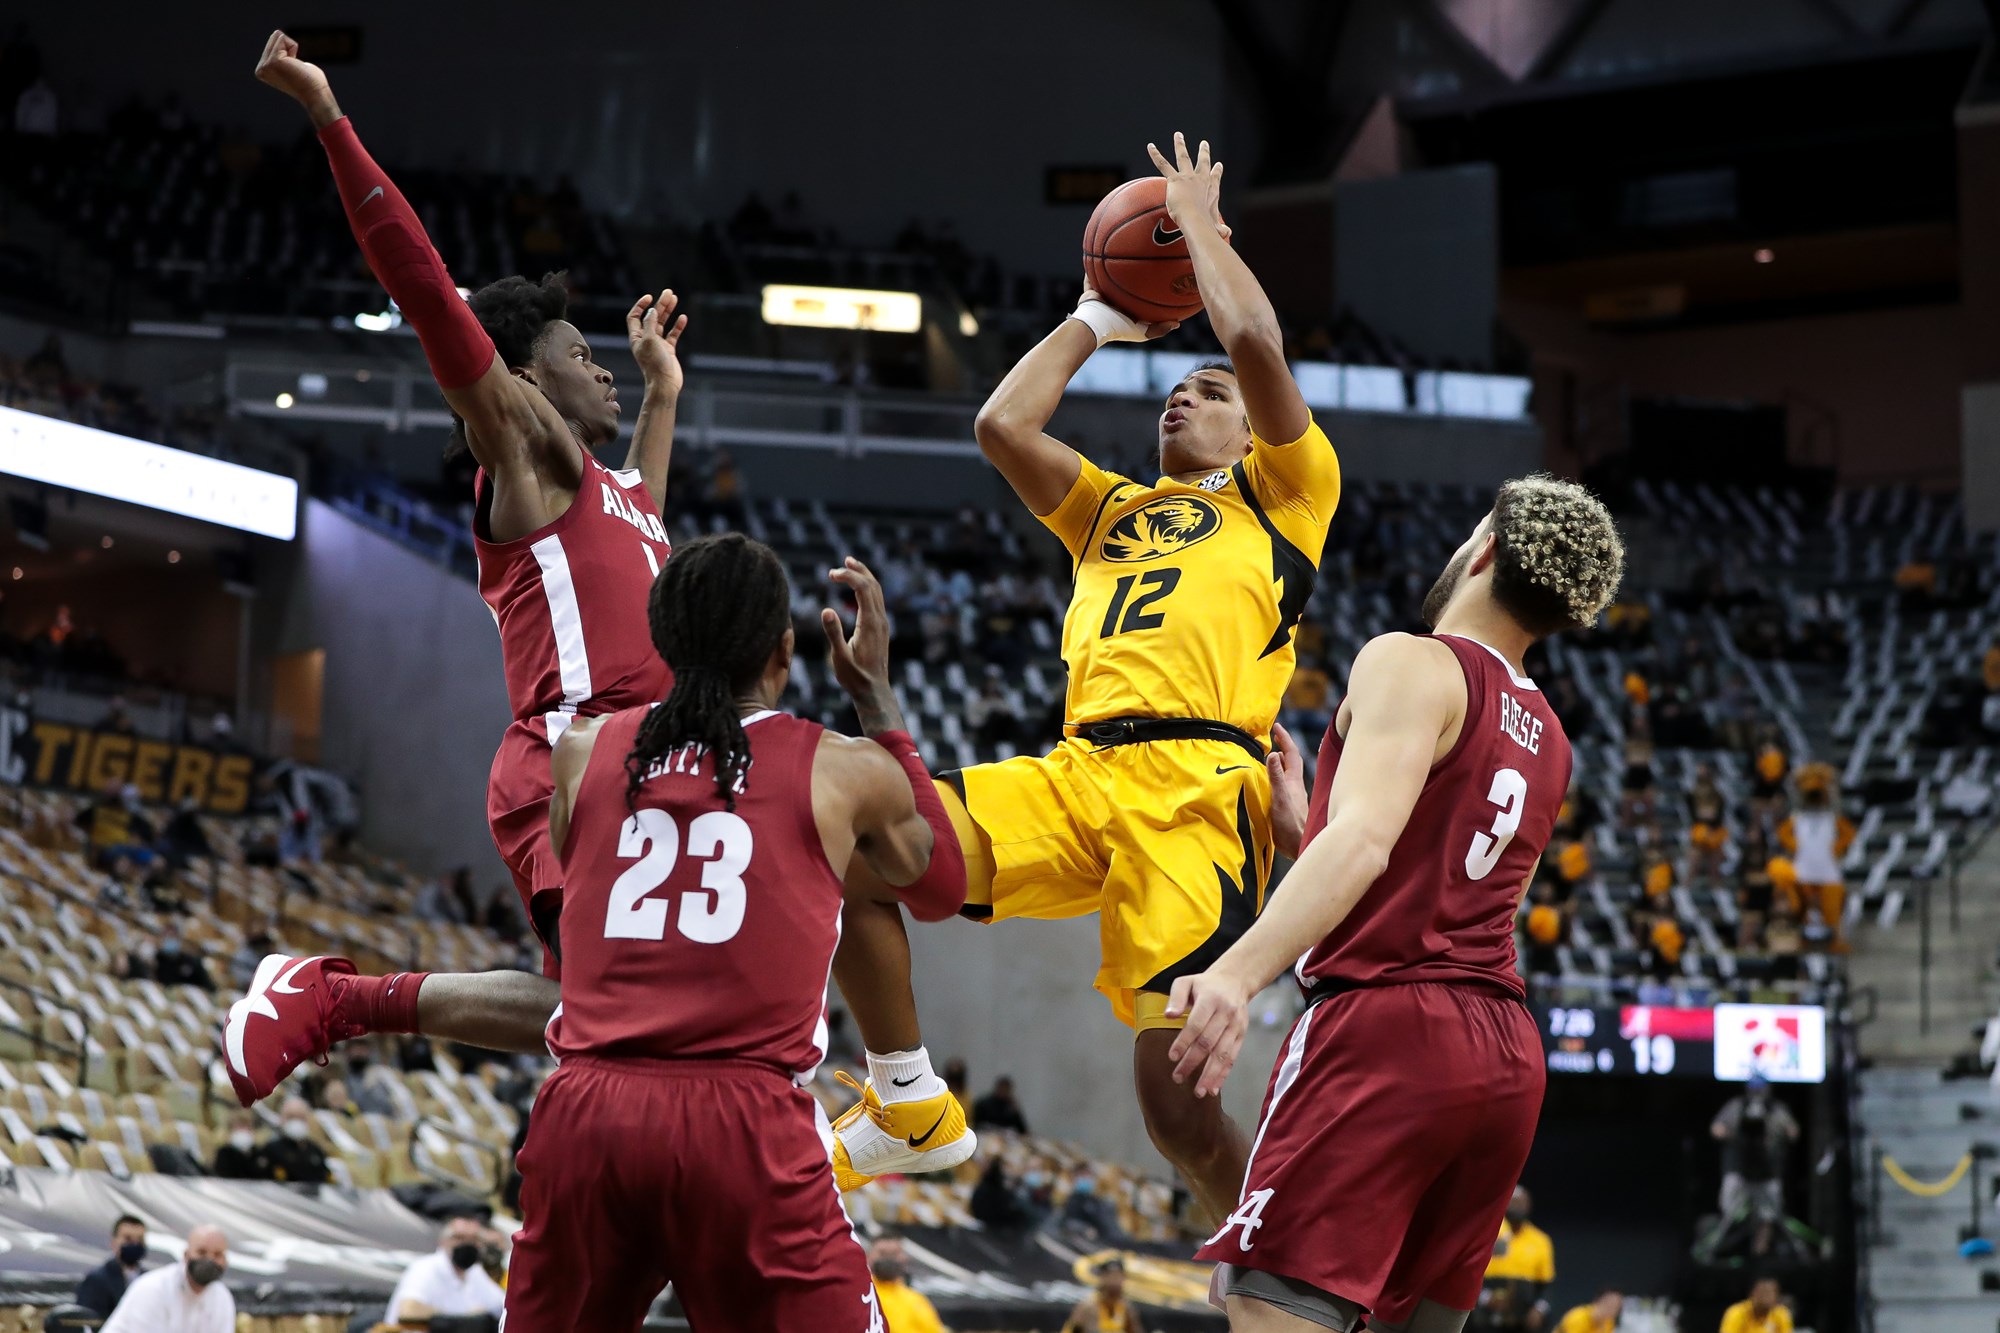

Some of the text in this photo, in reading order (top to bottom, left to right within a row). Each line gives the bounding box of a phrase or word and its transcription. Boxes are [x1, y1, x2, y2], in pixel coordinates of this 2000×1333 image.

[1199, 471, 1225, 489] SEC
[1100, 567, 1182, 639] 12
[1501, 691, 1543, 755] REESE
[33, 722, 254, 812] TIGERS
[1465, 768, 1527, 880] 3
[604, 808, 754, 944] 23
[1631, 1035, 1675, 1074] 19
[1204, 1187, 1275, 1252] A
